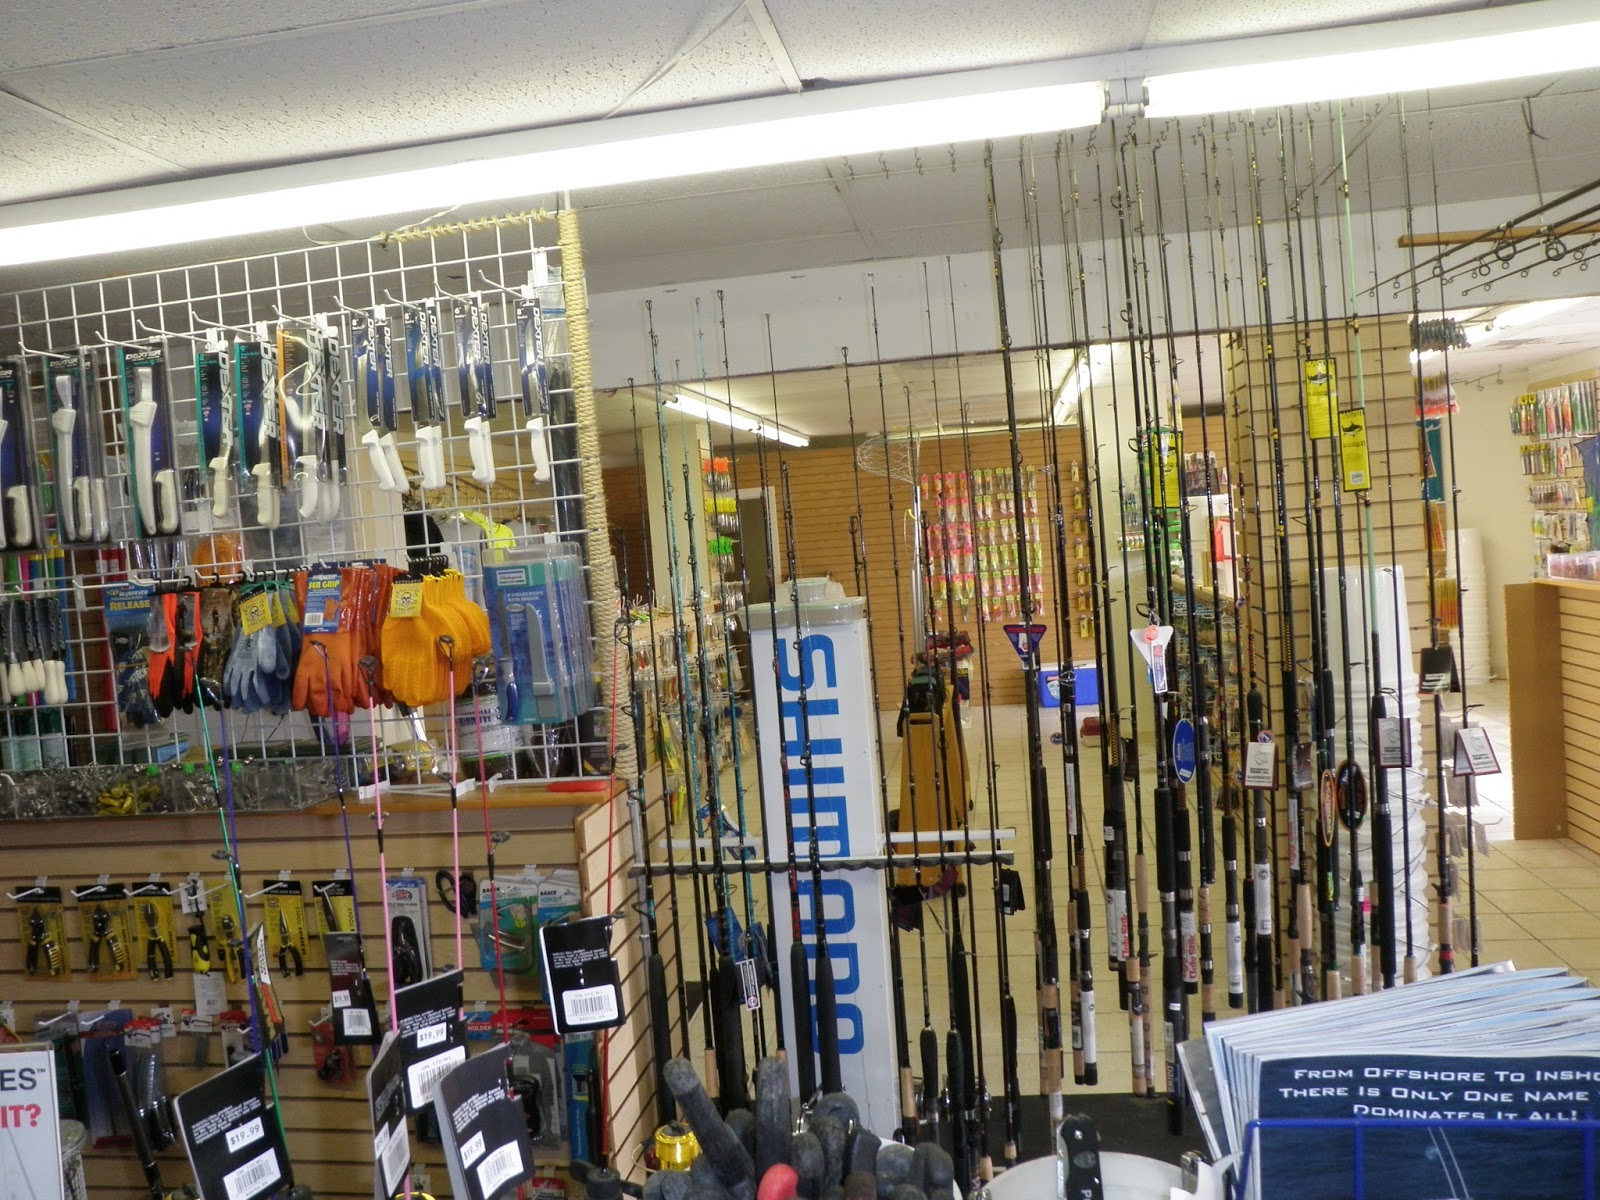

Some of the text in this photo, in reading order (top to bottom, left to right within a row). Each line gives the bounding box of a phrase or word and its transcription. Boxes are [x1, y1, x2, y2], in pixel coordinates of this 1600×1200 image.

[322, 580, 340, 588] GRIP
[109, 600, 150, 610] RELEASE
[419, 1028, 445, 1042] $19.99
[1294, 1068, 1353, 1079] FROM
[1364, 1067, 1485, 1081] OFFSHORE
[1494, 1071, 1525, 1082] TO
[1279, 1086, 1589, 1102] THERE IS ONLY ONE NAME
[1353, 1104, 1485, 1120] DOMINATES
[1529, 1110, 1577, 1121] ALL!
[230, 1124, 260, 1146] $19.99
[463, 1138, 482, 1160] $19.99
